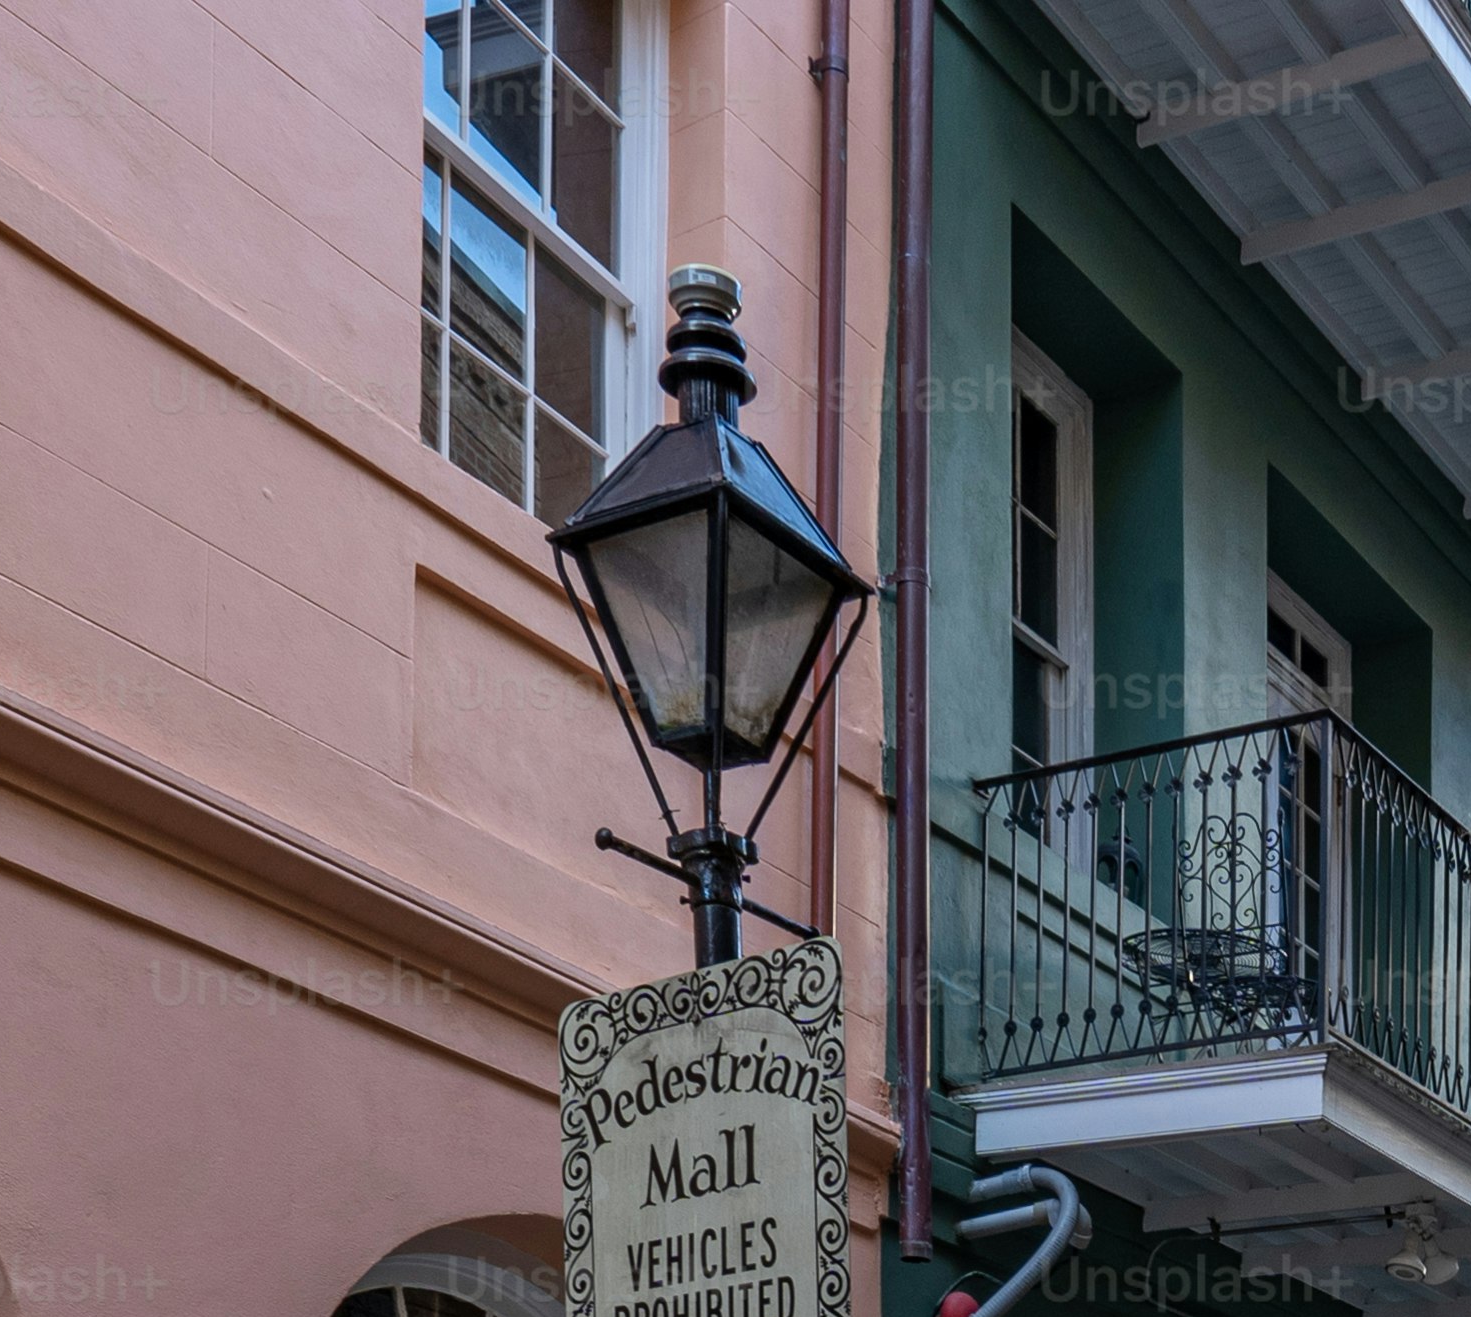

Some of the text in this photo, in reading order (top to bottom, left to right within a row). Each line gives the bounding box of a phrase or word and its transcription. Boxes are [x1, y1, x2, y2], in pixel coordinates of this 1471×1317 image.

[575, 1036, 820, 1153] Pedestrian
[639, 1122, 761, 1209] Mall
[627, 1216, 777, 1292] VEHICLES
